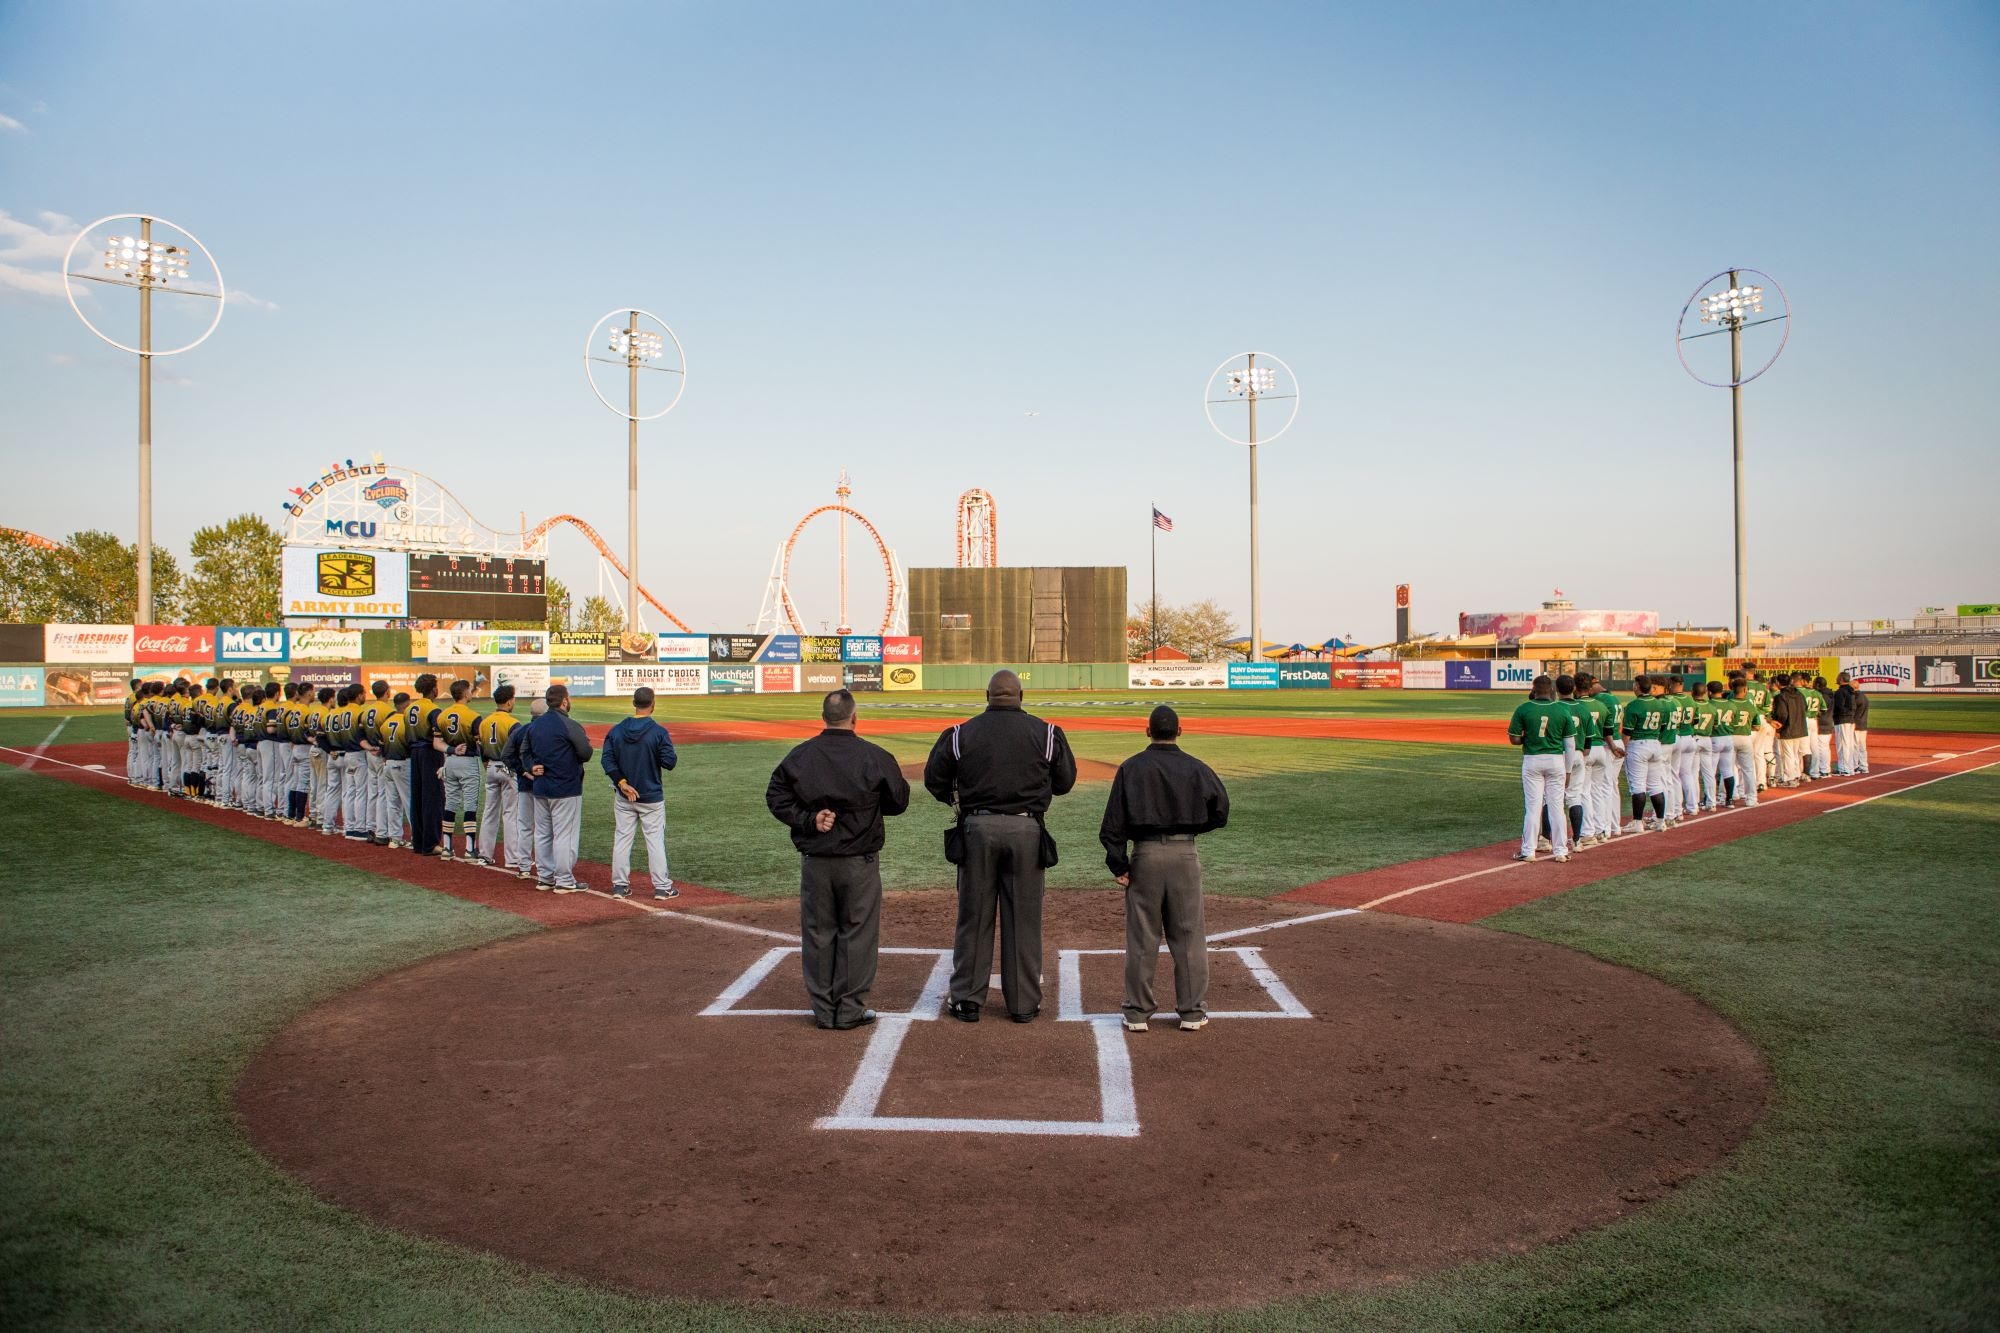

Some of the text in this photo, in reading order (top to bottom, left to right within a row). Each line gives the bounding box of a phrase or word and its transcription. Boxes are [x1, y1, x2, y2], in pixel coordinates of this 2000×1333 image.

[365, 486, 407, 501] CYCLONES
[326, 519, 449, 543] MCU PARK
[321, 553, 373, 563] LEADERSHIP
[451, 560, 458, 570] 0
[480, 562, 486, 571] 0
[507, 563, 513, 572] 0
[321, 587, 372, 596] EXCELLENCE
[289, 600, 403, 615] ARMY ROTC
[222, 631, 282, 652] MCU
[292, 633, 358, 652] Gargiulo's
[561, 632, 605, 640] DURANTE
[135, 635, 191, 653] Coca-Cola
[846, 642, 881, 652] EVENT HERE
[1760, 657, 1777, 665] THE
[1779, 657, 1820, 665] CLOWNS
[223, 670, 263, 679] GLASSES UP
[615, 669, 700, 678] THE RIGHT CHOICE
[710, 669, 754, 680] Northfield
[807, 673, 837, 684] verizon
[1018, 672, 1031, 680] 412
[1280, 670, 1302, 680] First
[1859, 664, 1911, 680] FRANCIS
[325, 714, 341, 733] 16
[367, 708, 377, 729] 8
[408, 705, 420, 727] 6
[447, 712, 460, 735] 3
[1642, 711, 1661, 730] 18
[1717, 708, 1733, 726] 14
[1738, 710, 1749, 727] 3
[388, 721, 399, 742] 7
[489, 721, 497, 745] 1
[1538, 715, 1549, 737] 1
